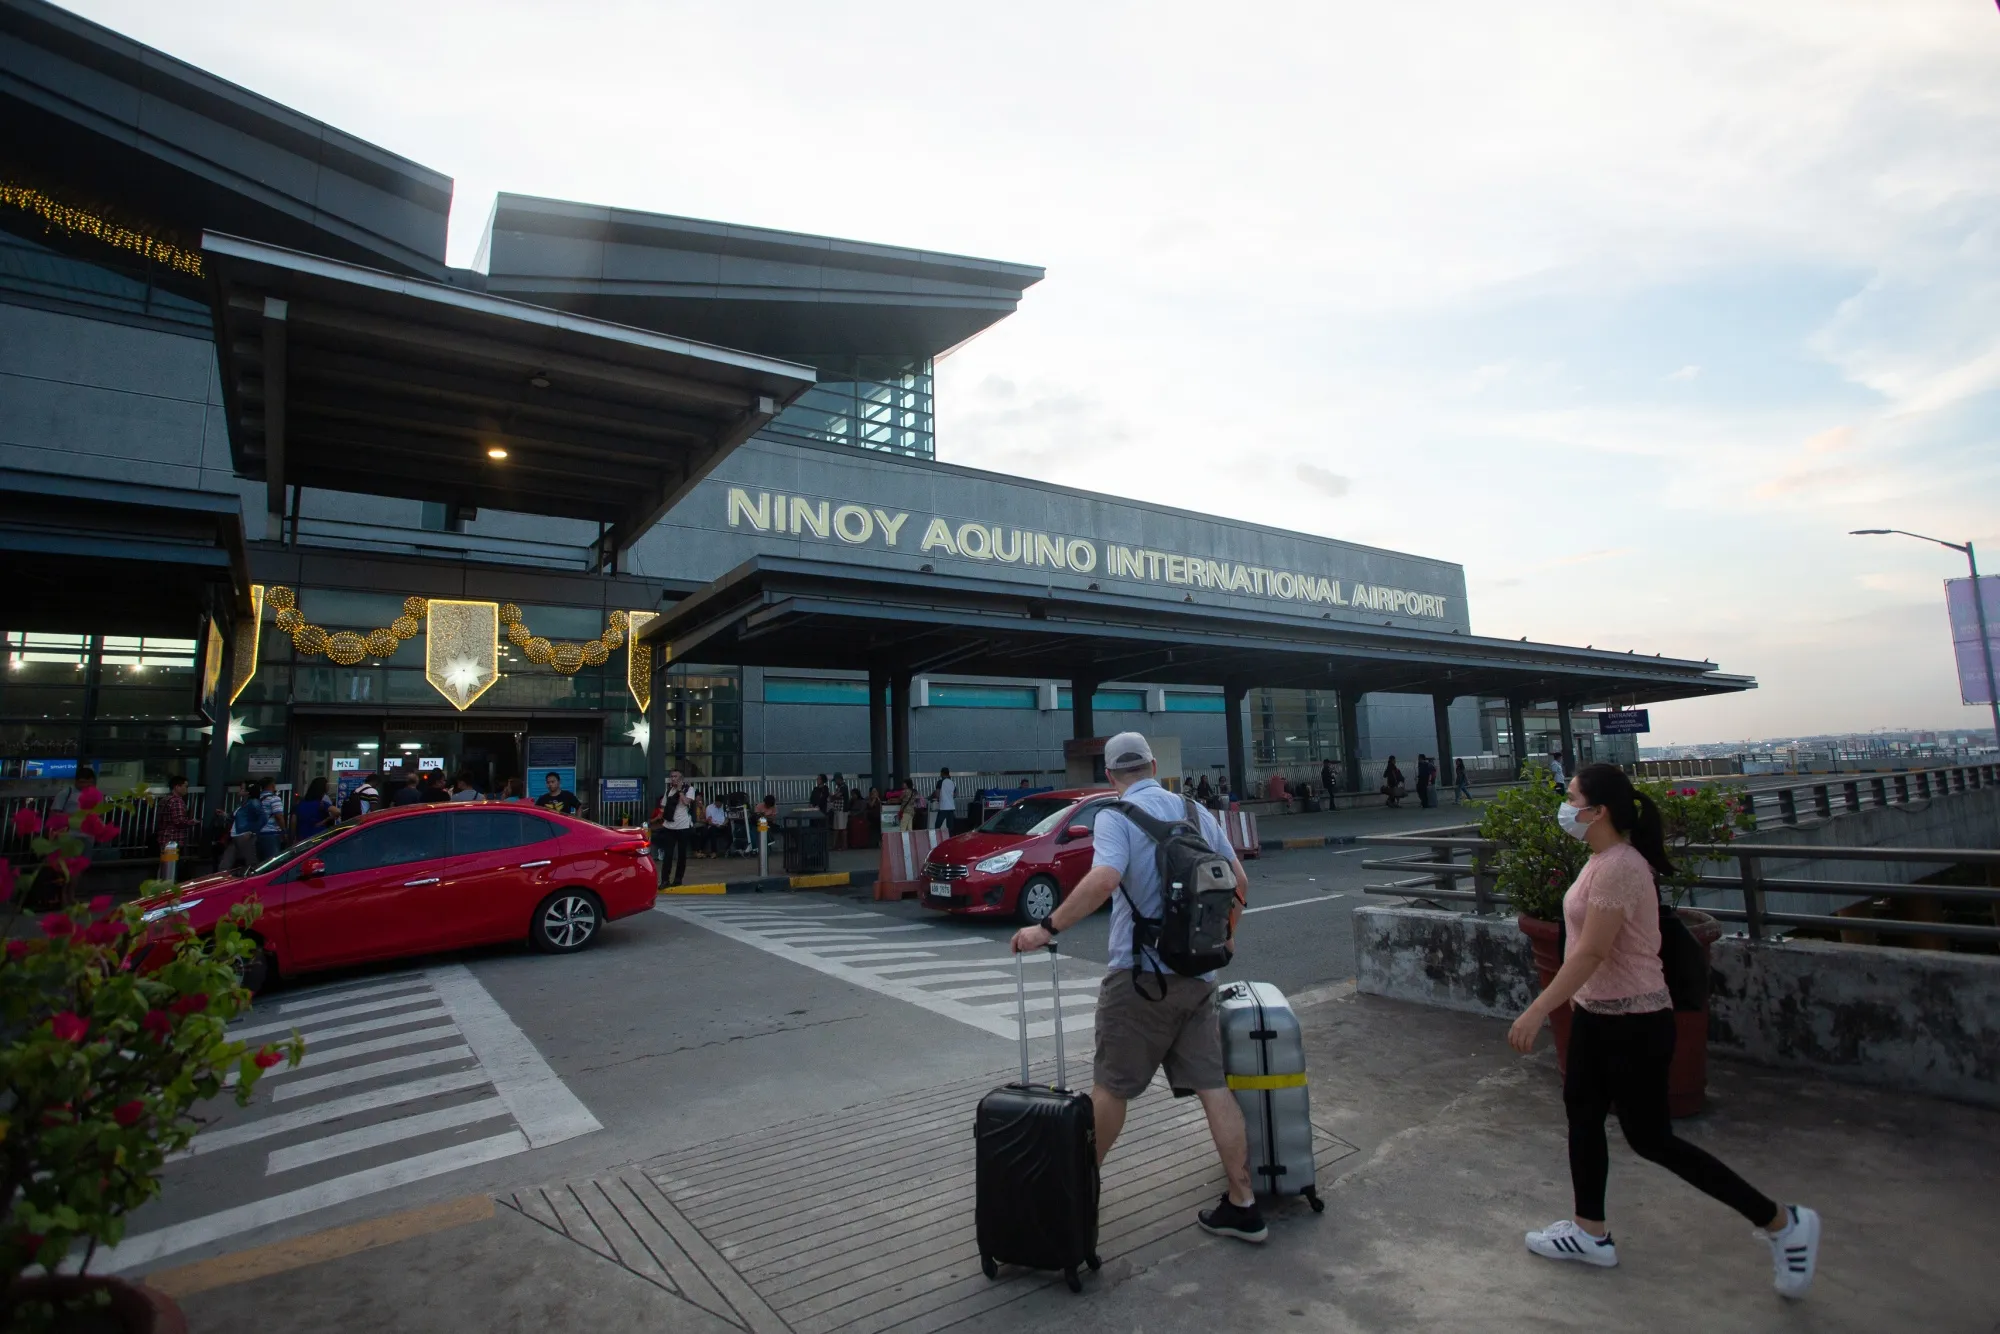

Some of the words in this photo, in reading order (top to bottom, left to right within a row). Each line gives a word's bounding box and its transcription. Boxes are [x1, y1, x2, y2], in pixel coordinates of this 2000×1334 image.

[728, 487, 908, 547] NINOY
[920, 518, 1098, 573] AQUINO
[1107, 545, 1349, 606] INTERNATIONAL
[1351, 582, 1446, 619] AIRPORT
